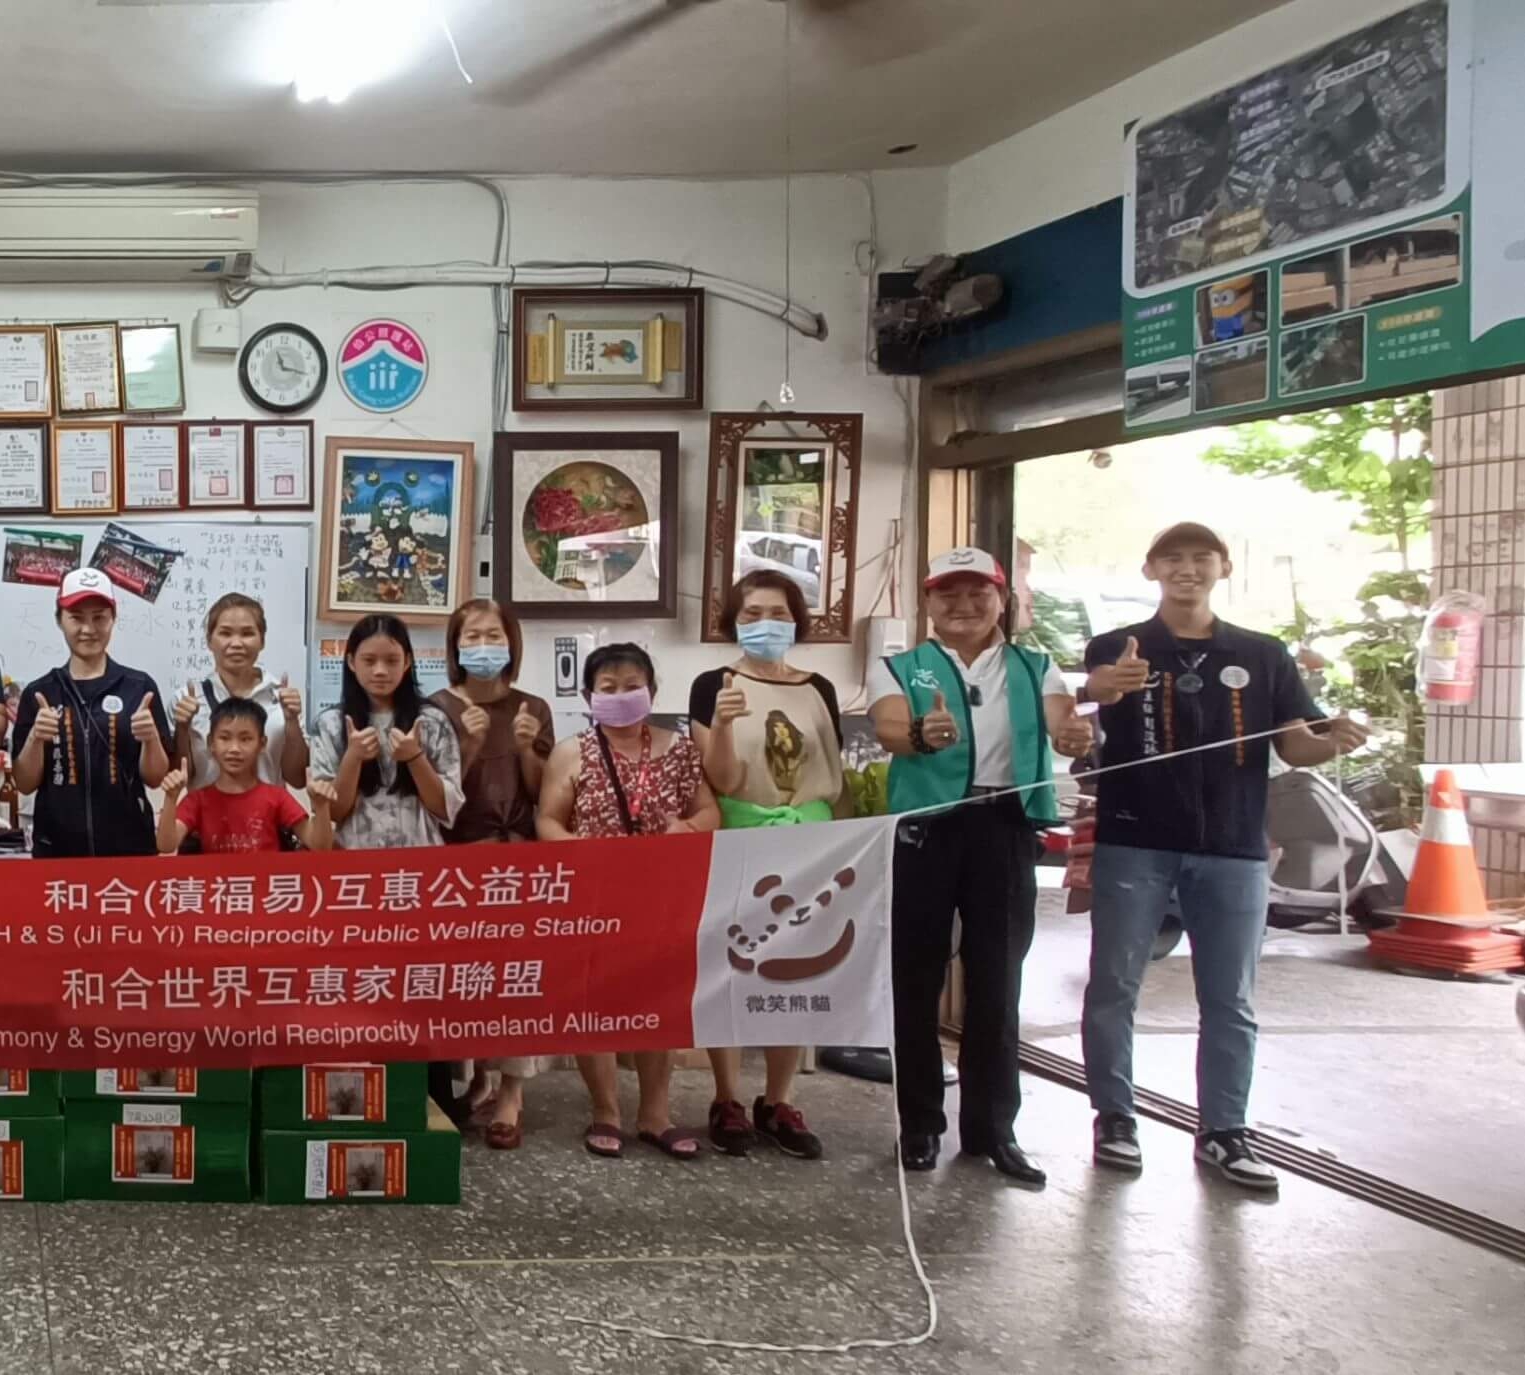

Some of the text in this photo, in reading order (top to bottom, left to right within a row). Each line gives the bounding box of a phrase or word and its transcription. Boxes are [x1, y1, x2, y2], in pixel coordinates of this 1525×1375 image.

[44, 862, 575, 917] 和合(積福易)互惠公益站
[20, 926, 38, 944] &
[47, 926, 64, 944] S
[74, 925, 101, 949] (Ji
[111, 926, 142, 945] Fu
[152, 925, 184, 947] Yi)
[194, 925, 334, 948] Reciprocity
[342, 924, 420, 944] Public
[428, 920, 525, 941] Welfare
[533, 917, 621, 938] Station
[62, 959, 544, 1011] 和合世界互惠家園聯盟
[746, 994, 831, 1014] 微笑熊貓
[67, 1028, 84, 1048] &
[93, 1026, 196, 1053] Synergy
[204, 1025, 277, 1047] World
[286, 1020, 420, 1048] Reciprocity
[428, 1014, 554, 1040] Homeland
[562, 1010, 660, 1034] Alliance
